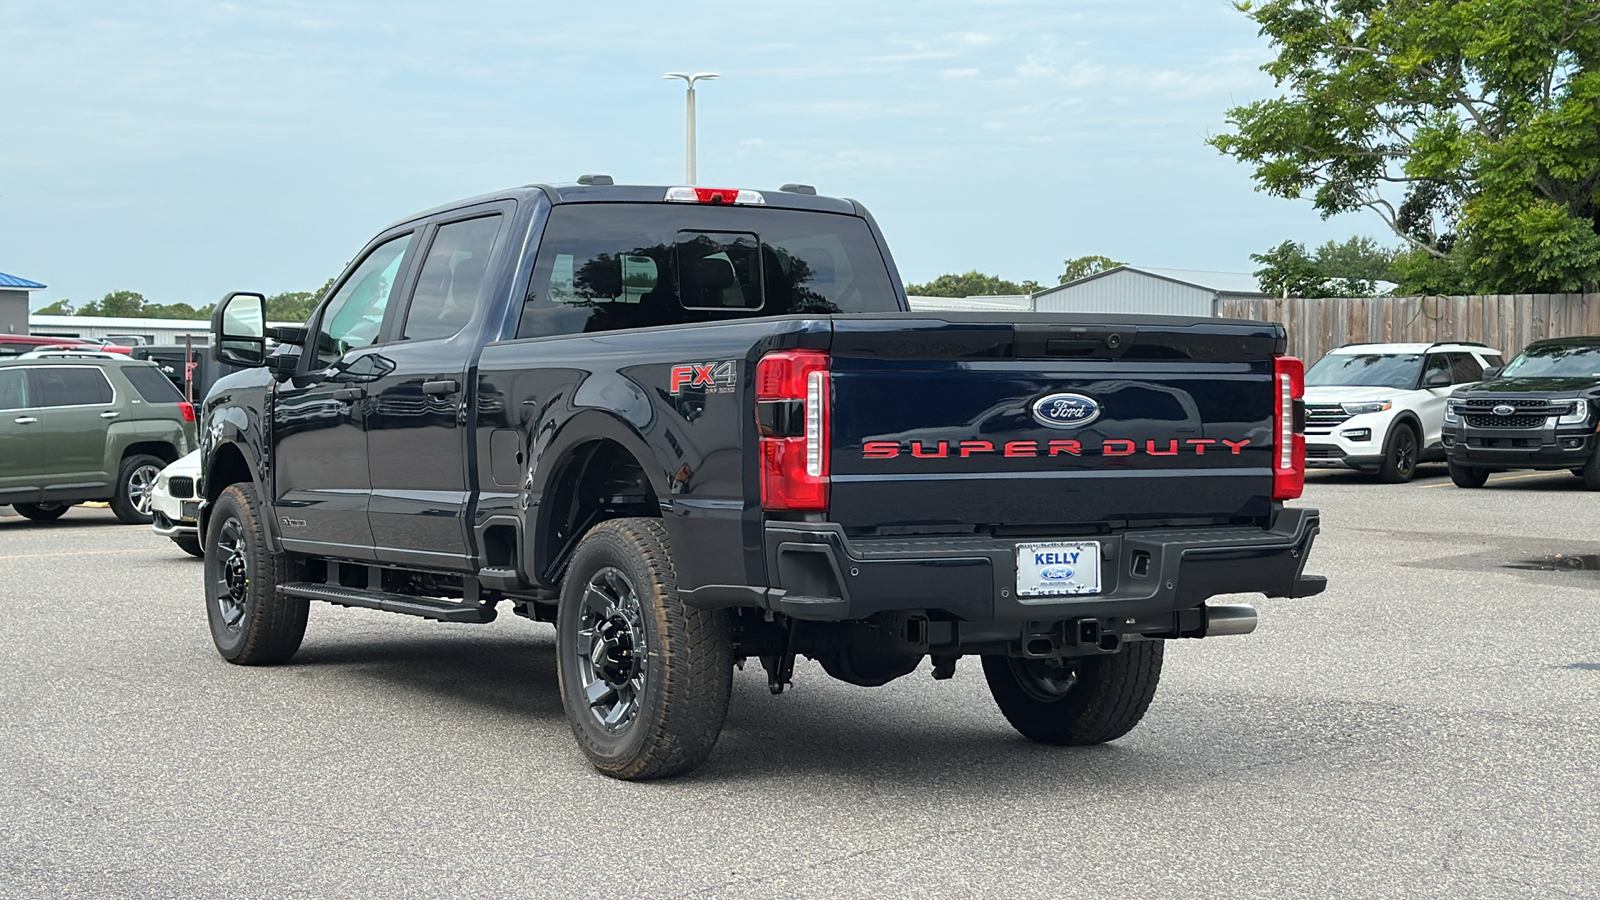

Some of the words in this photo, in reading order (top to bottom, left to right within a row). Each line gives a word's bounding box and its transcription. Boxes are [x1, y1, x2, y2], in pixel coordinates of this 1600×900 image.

[669, 360, 737, 396] FX4
[1050, 399, 1085, 418] Ford
[862, 439, 1082, 459] SUPER
[1102, 438, 1251, 455] DUTY
[1035, 552, 1080, 565] KELLY
[1047, 568, 1067, 578] Ford
